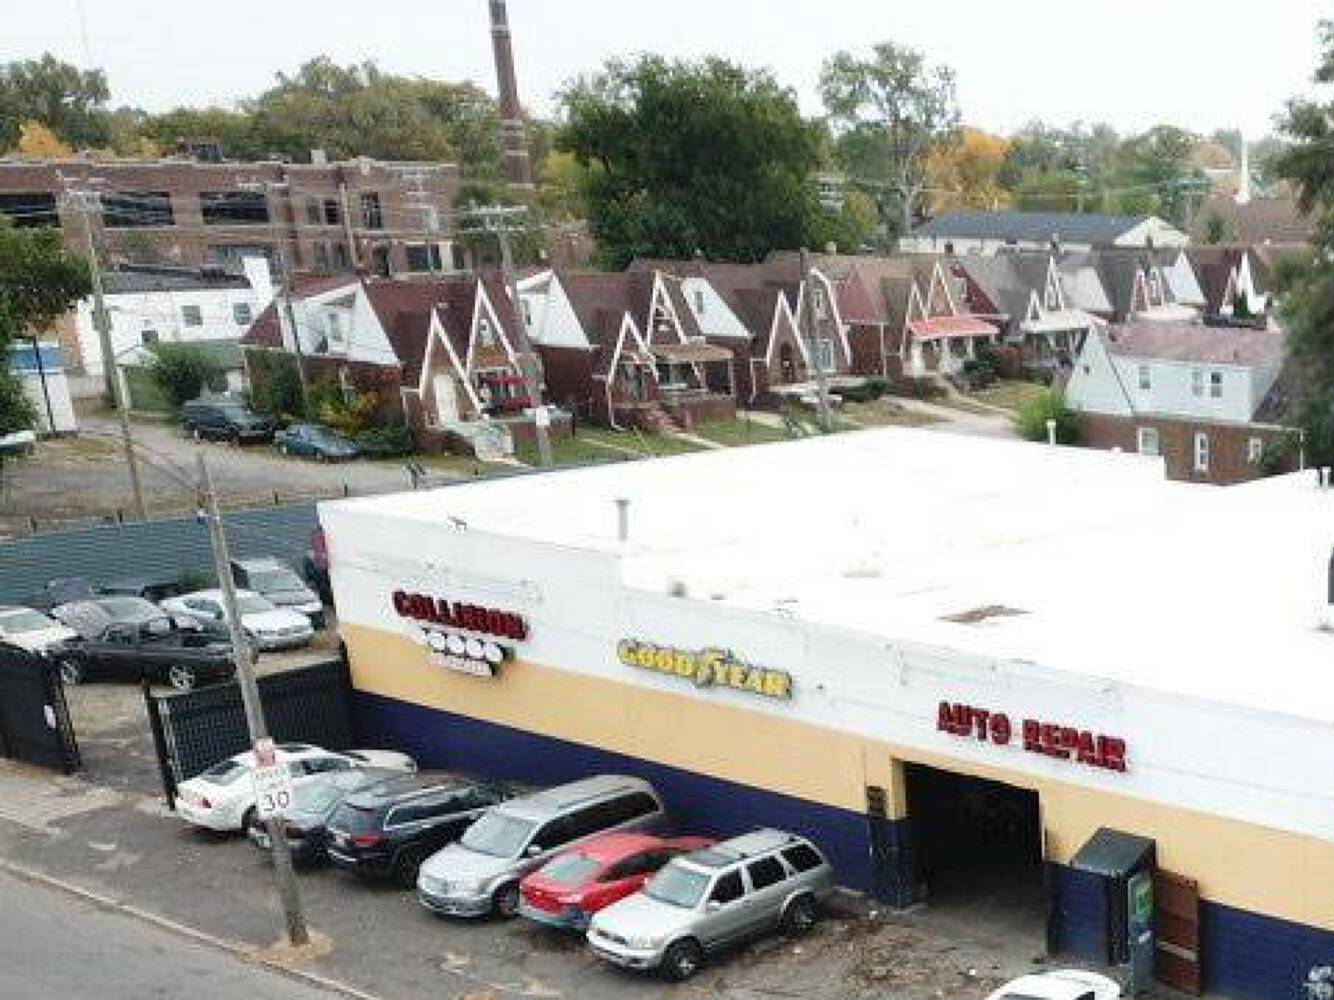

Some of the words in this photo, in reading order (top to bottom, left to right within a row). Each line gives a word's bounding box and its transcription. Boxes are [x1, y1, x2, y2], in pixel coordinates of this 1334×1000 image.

[393, 589, 525, 641] COLLISION
[937, 700, 1011, 745] AUTO
[1022, 718, 1127, 772] REPAIR
[263, 791, 290, 812] 30
